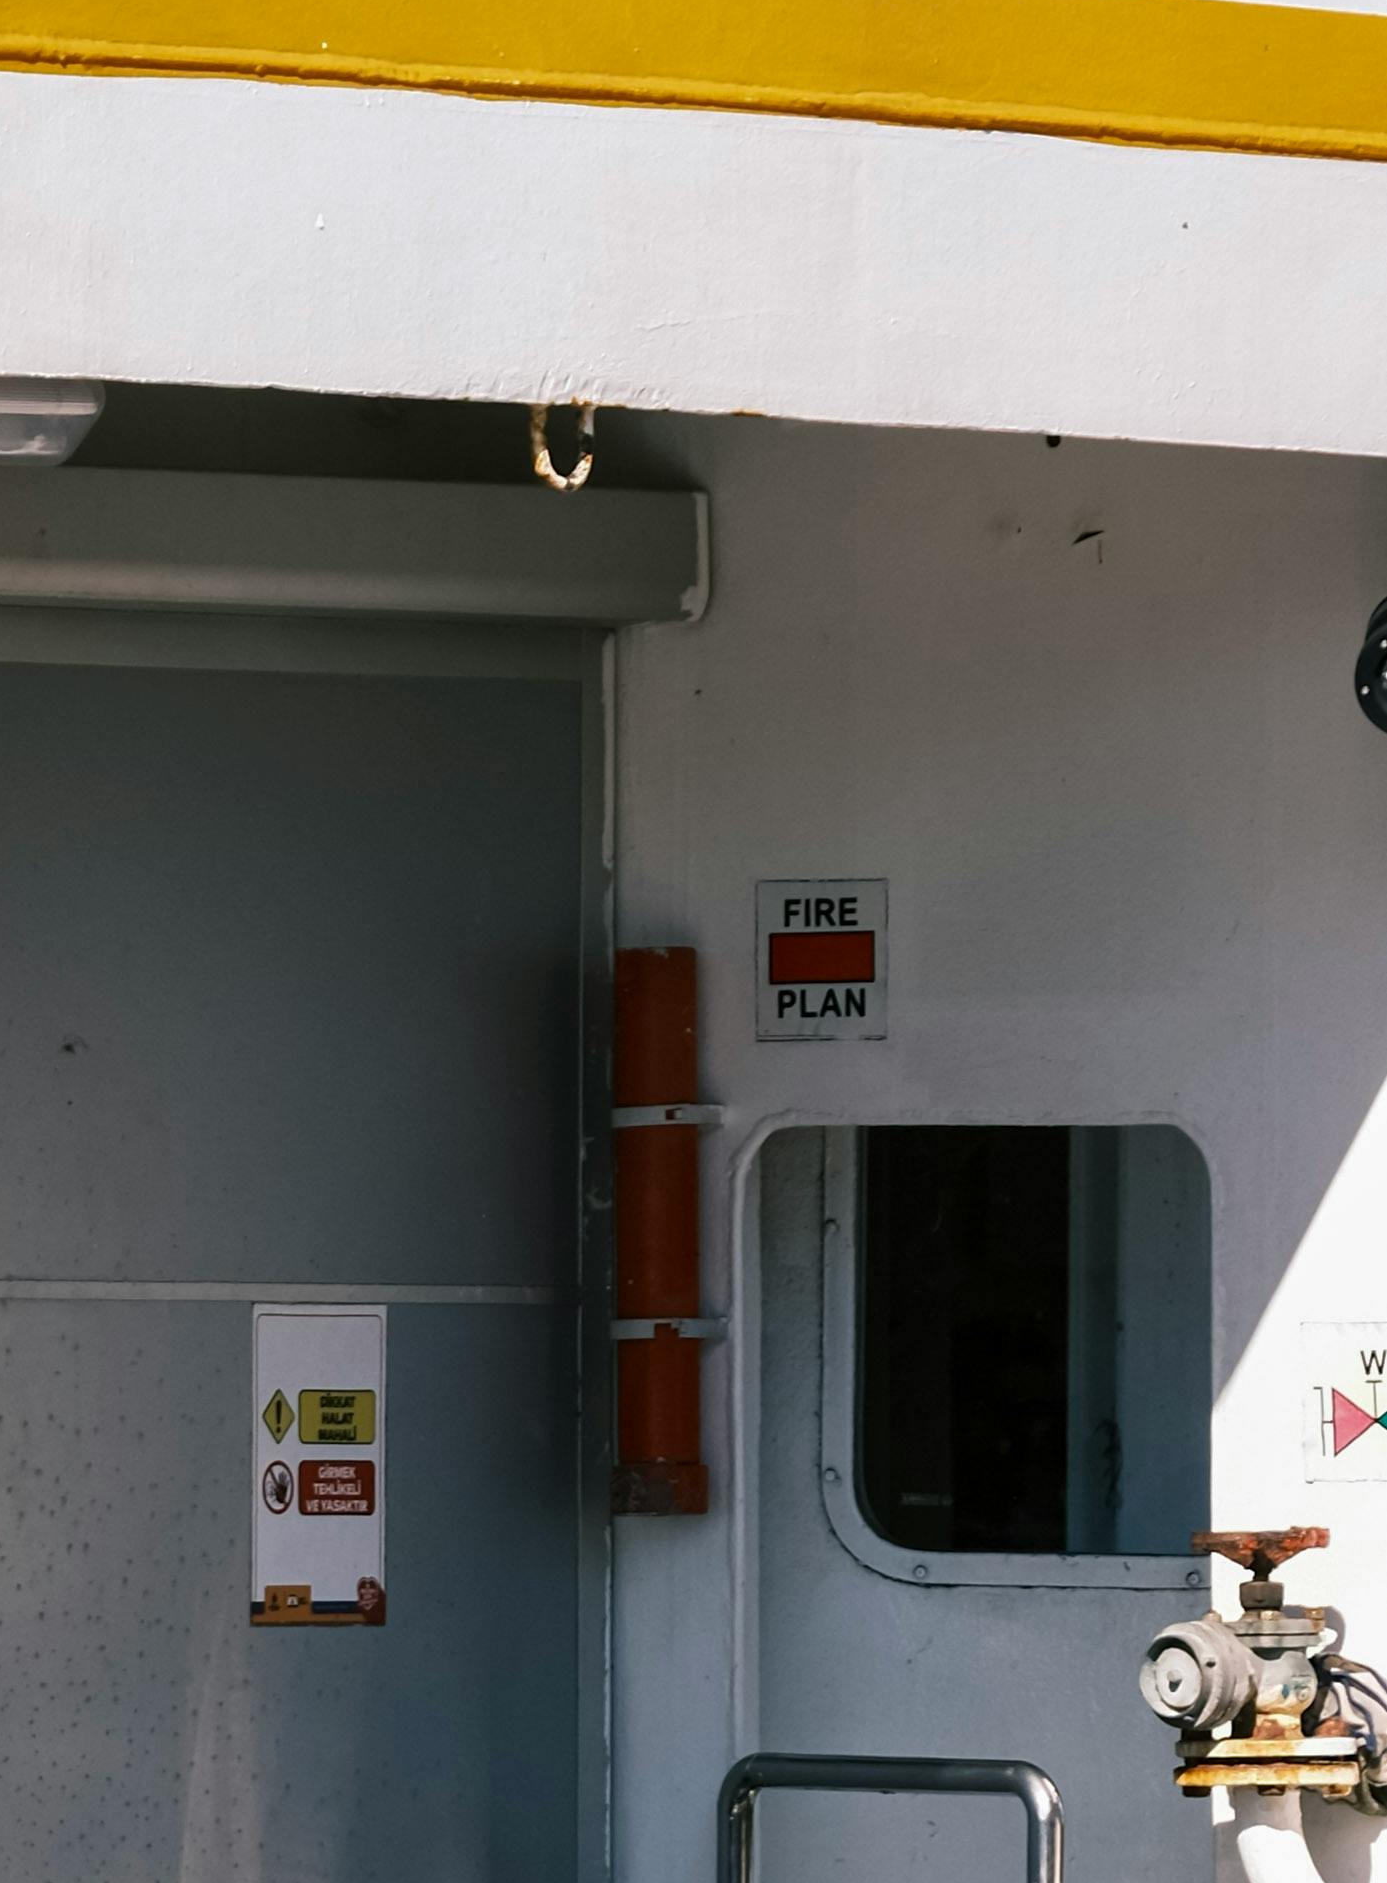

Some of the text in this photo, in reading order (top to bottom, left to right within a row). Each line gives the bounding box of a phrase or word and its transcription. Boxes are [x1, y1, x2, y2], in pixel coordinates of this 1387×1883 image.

[784, 897, 858, 927] FIRE
[777, 988, 867, 1019] PLAN
[305, 1500, 319, 1512] VE
